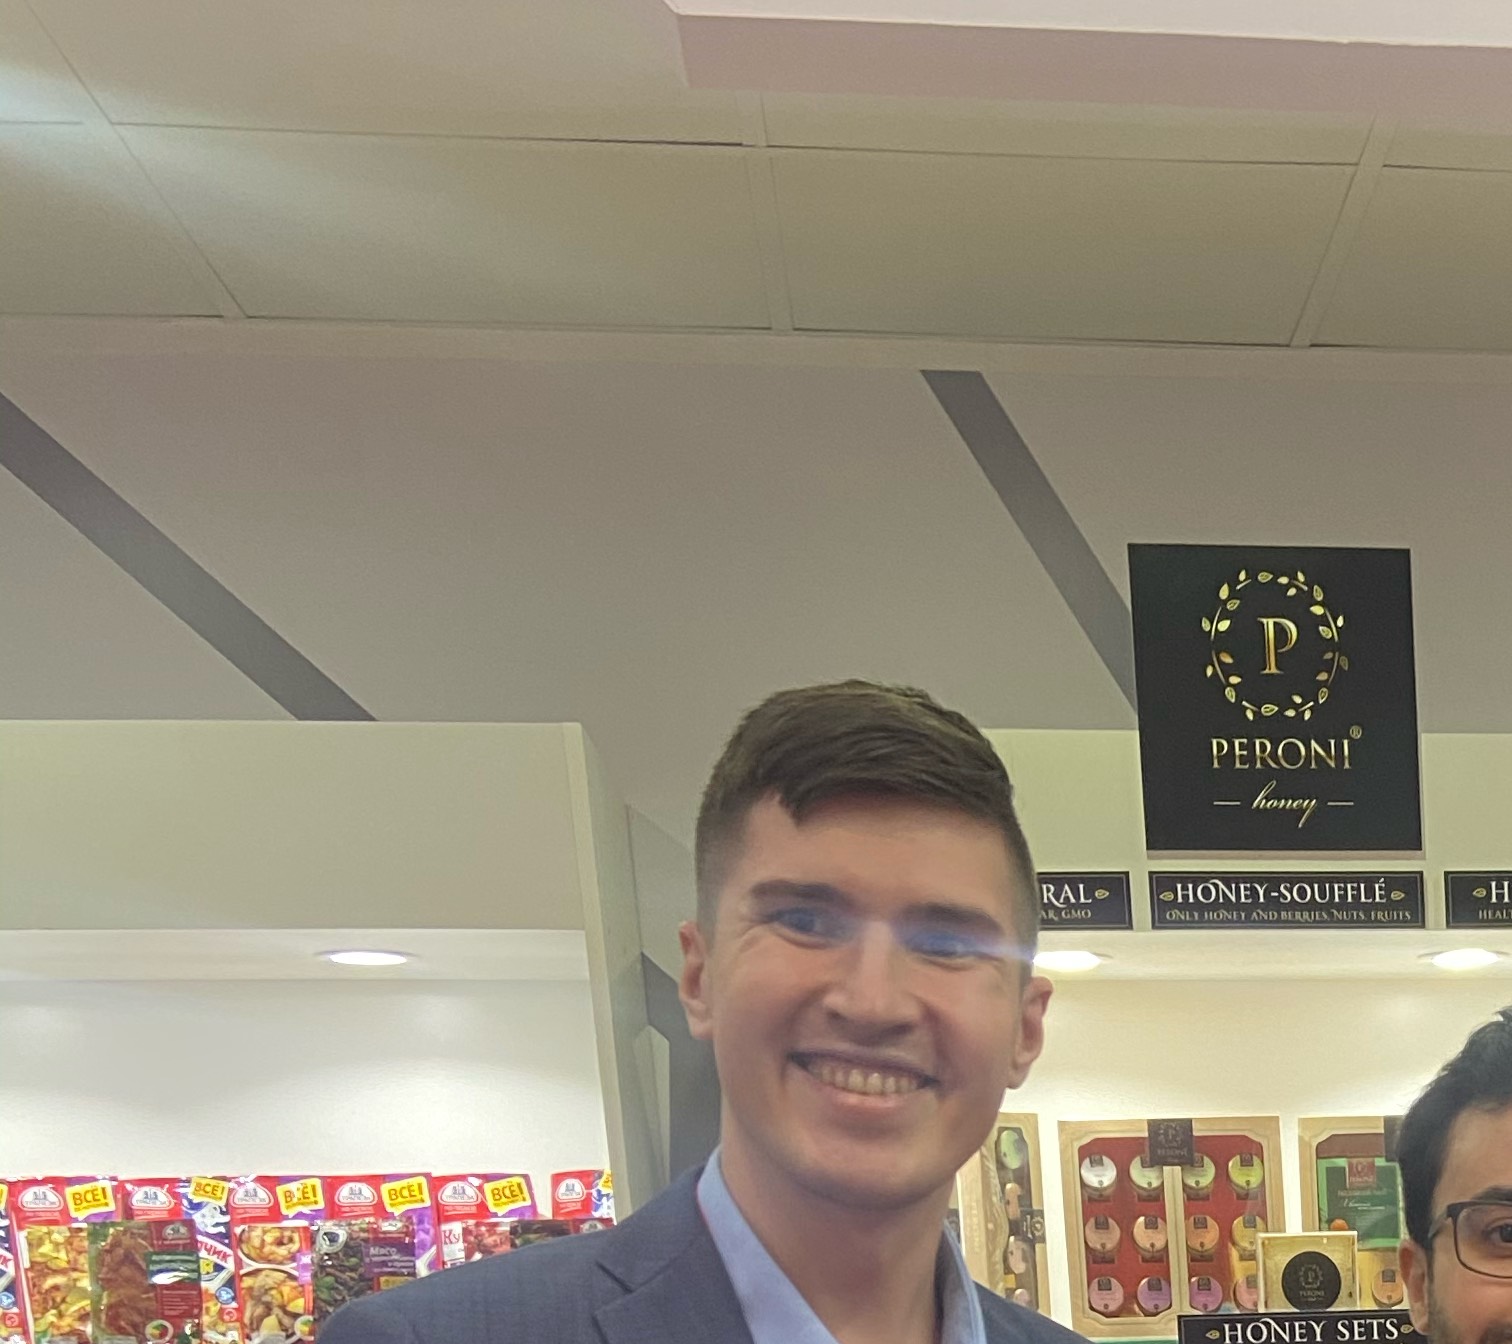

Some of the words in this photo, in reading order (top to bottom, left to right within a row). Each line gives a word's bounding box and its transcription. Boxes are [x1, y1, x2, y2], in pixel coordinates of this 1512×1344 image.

[1257, 616, 1298, 674] P
[1251, 779, 1319, 829] honey
[1041, 883, 1093, 909] RAL
[1175, 877, 1387, 904] HONEY-SOUFFLÉ
[1061, 908, 1092, 920] GMO
[1165, 908, 1200, 921] ONLY
[1204, 908, 1246, 921] HONEY
[1251, 908, 1278, 921] AND
[1370, 908, 1412, 921] FRUITS
[1336, 1317, 1399, 1342] SETS
